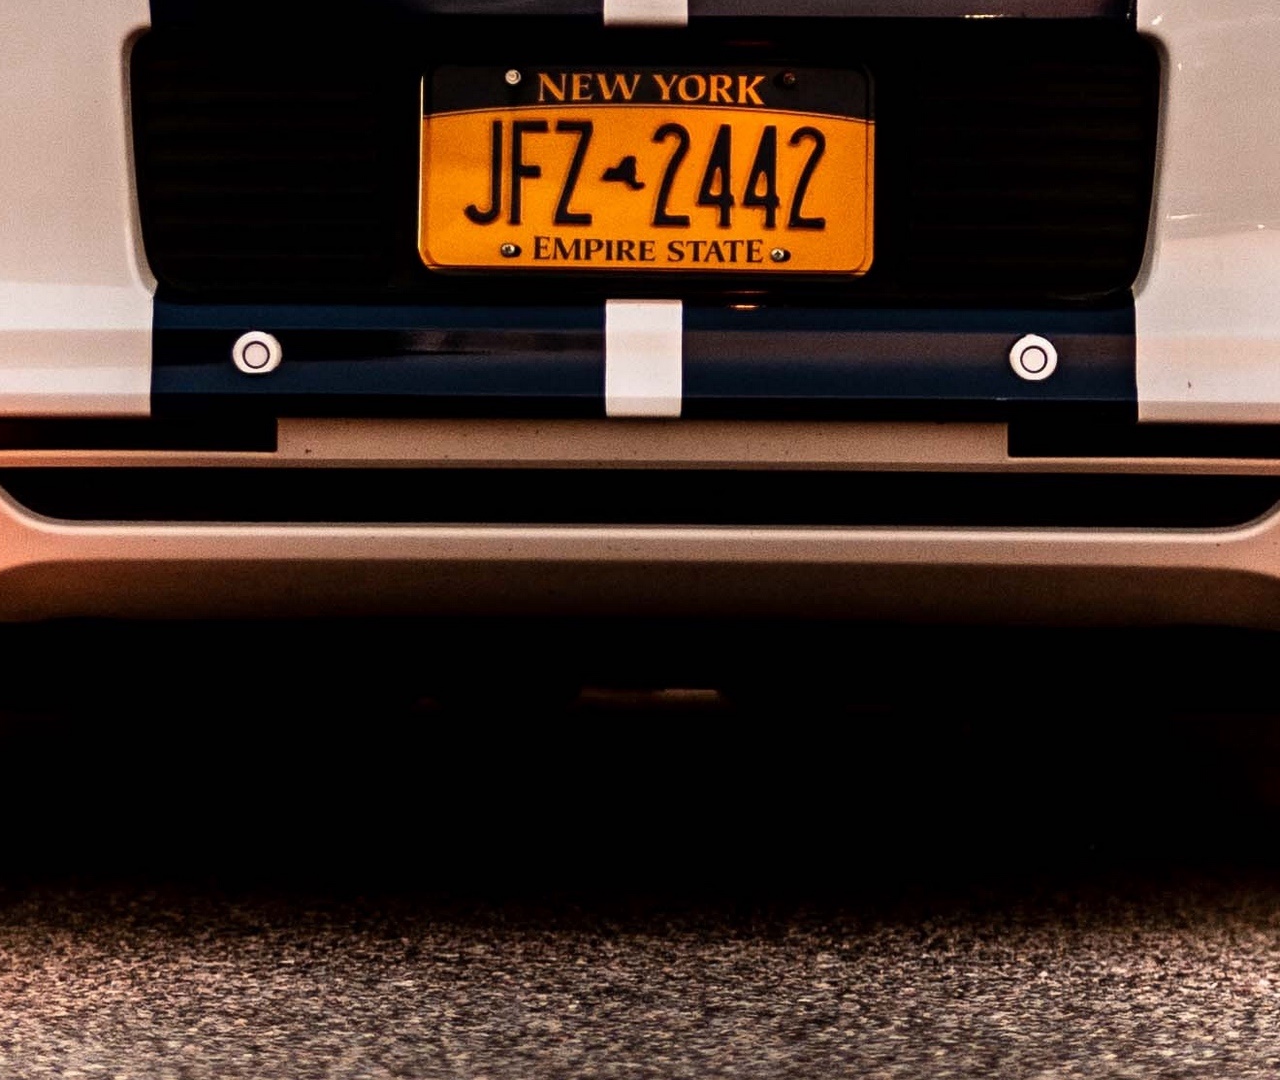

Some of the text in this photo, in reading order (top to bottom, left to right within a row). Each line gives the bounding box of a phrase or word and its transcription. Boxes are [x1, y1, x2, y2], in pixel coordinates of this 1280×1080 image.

[538, 73, 766, 105] NEW YORK
[464, 121, 826, 231] JFZ 2442
[533, 236, 764, 264] EMPIRE STATE
